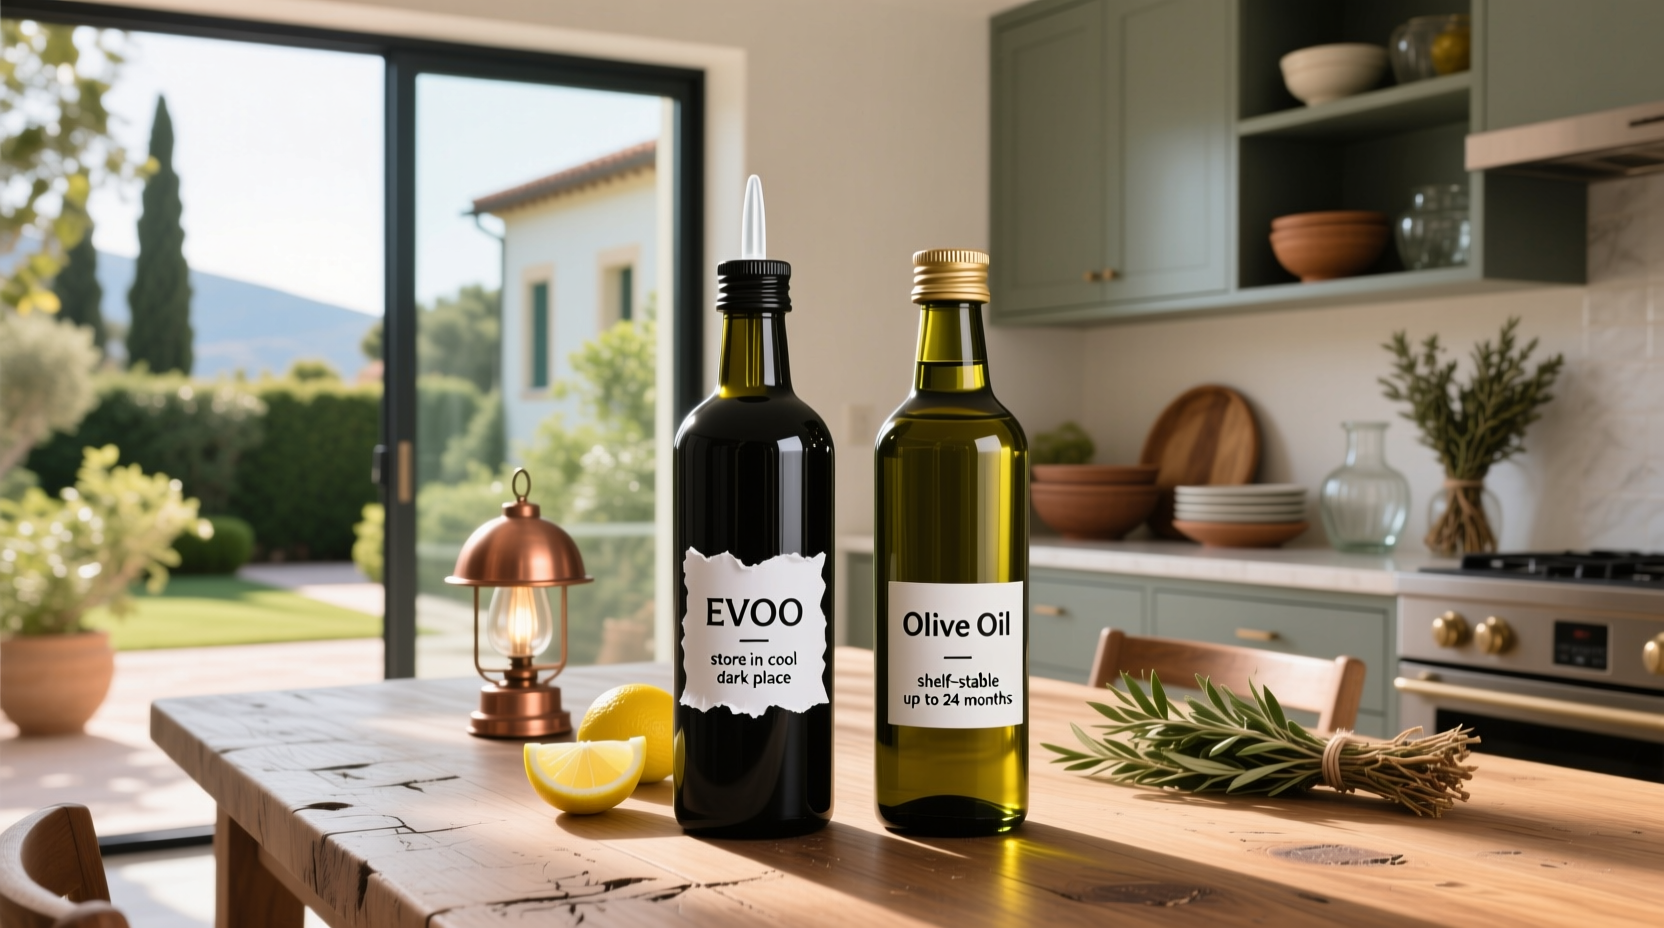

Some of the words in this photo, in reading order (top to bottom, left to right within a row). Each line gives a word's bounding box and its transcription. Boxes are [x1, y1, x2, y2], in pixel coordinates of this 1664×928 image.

[705, 597, 803, 628] EVOO
[902, 610, 971, 638] Olive
[976, 610, 1010, 637] Oil
[710, 653, 747, 666] store
[749, 651, 764, 667] in
[767, 650, 797, 666] cool
[716, 669, 749, 685] dark
[753, 669, 792, 689] place
[917, 671, 1000, 689] shelf-stable
[903, 694, 921, 710] up
[924, 693, 940, 706] to
[942, 692, 960, 707] 24
[964, 690, 1013, 707] months
